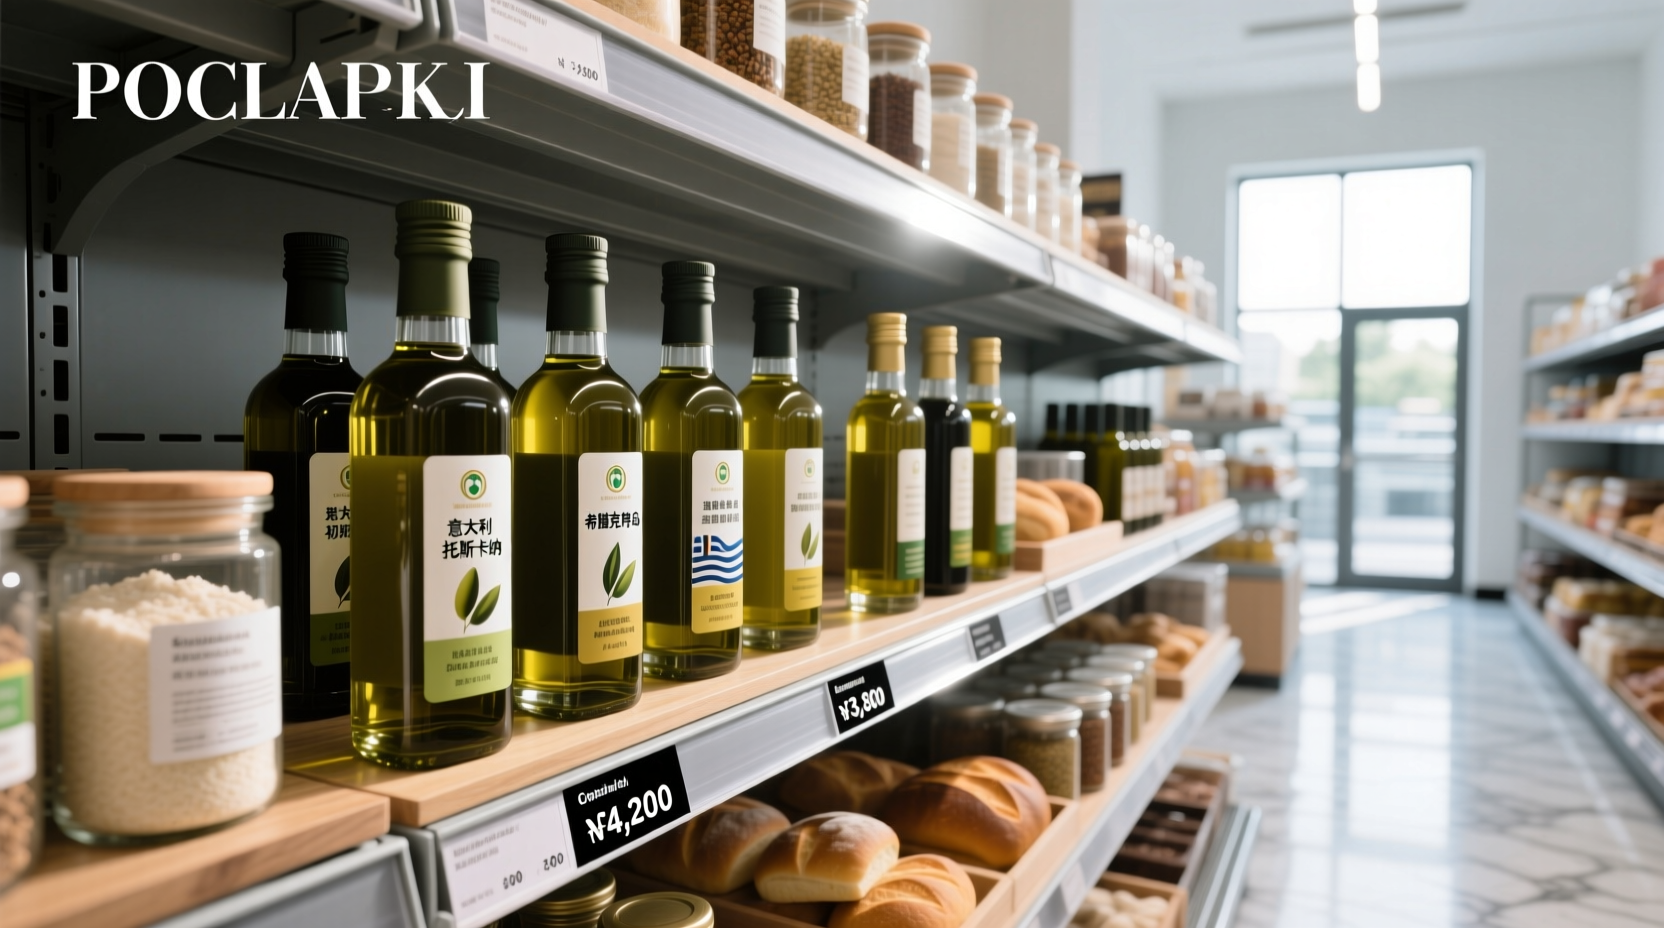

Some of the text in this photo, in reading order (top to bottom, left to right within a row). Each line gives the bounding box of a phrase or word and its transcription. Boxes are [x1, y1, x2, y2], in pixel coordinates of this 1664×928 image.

[447, 517, 493, 537] 意大利
[441, 538, 502, 560] 托斯卡纳
